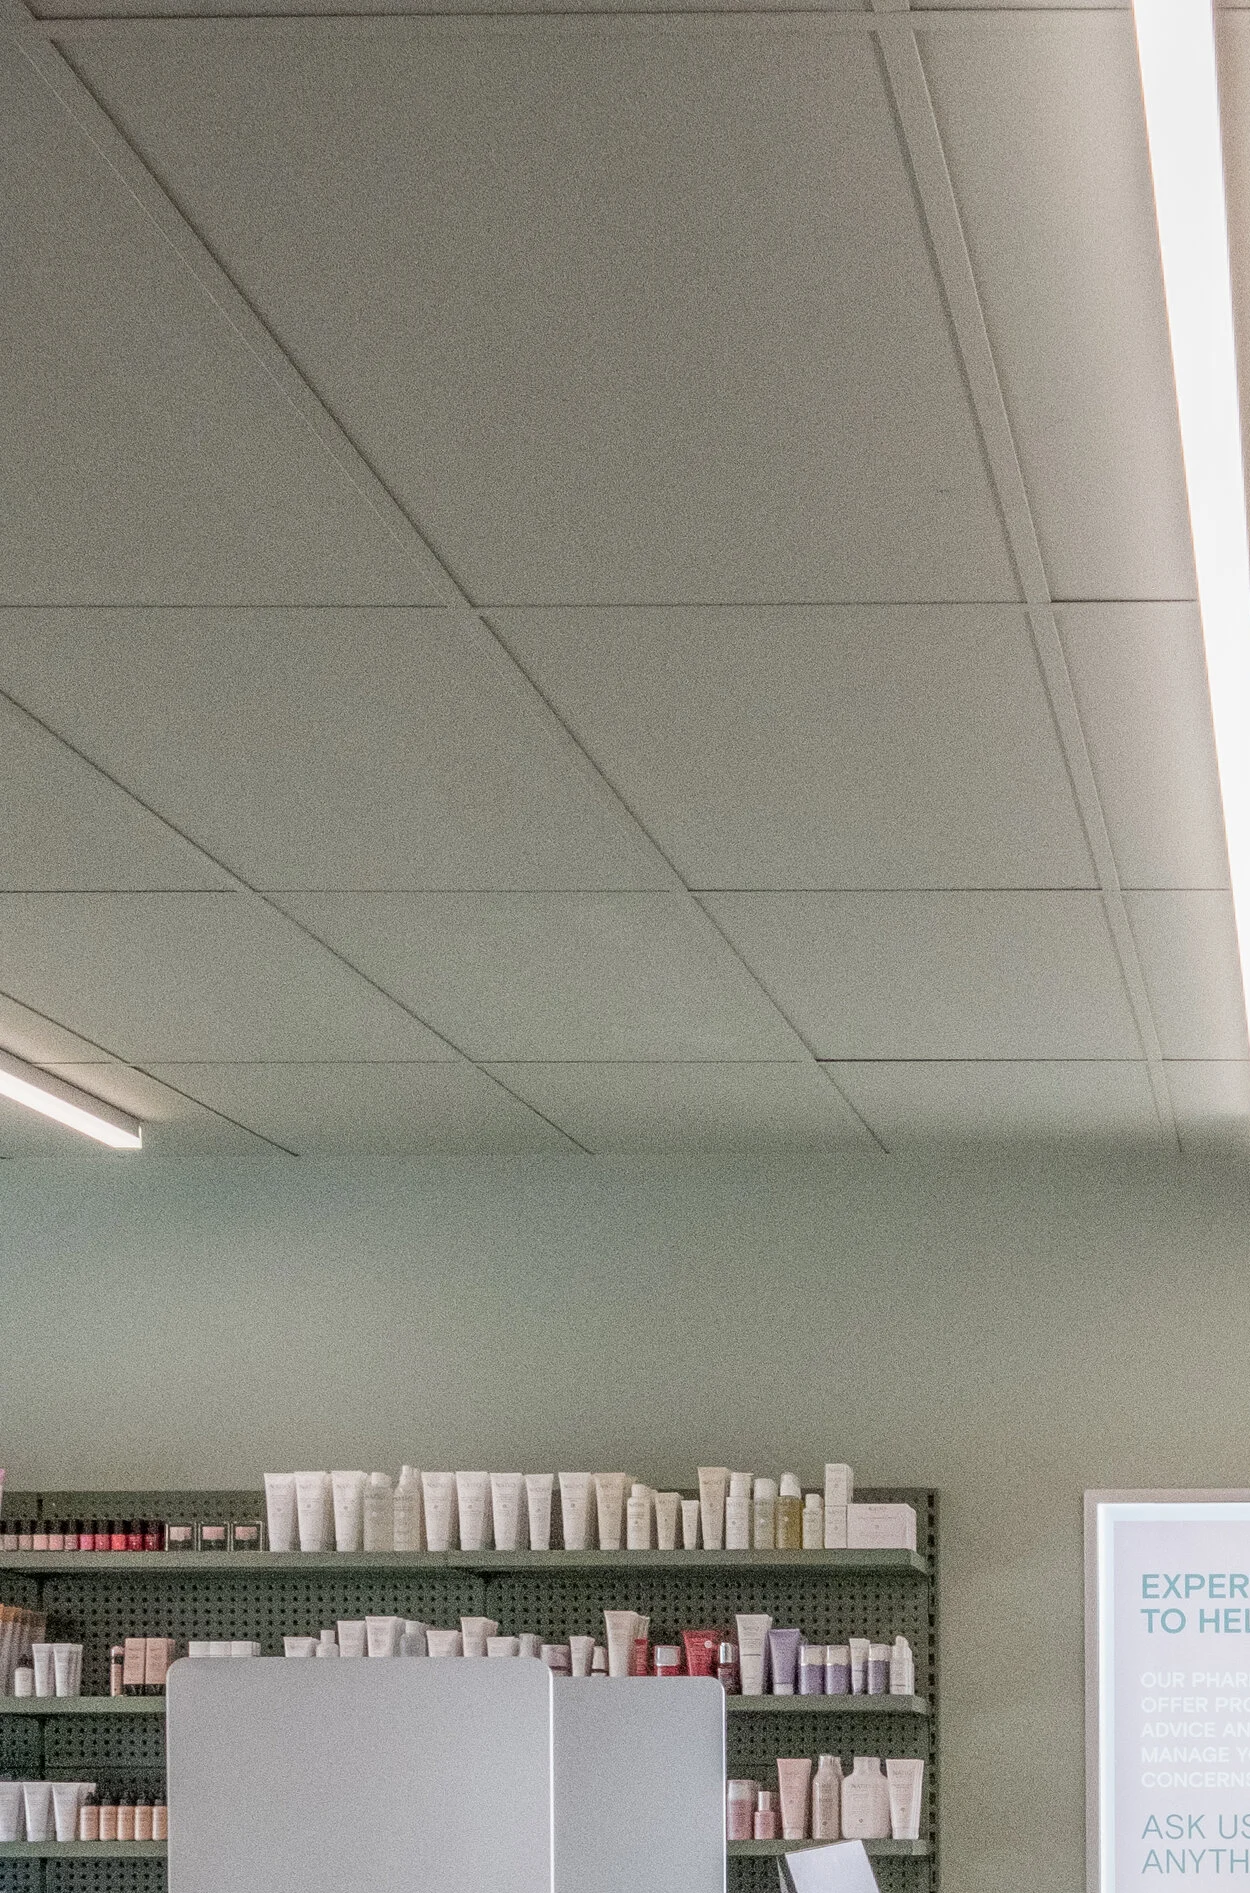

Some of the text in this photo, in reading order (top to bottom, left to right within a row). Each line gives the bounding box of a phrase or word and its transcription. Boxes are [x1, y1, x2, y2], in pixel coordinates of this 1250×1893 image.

[1140, 1608, 1186, 1634] TO
[1141, 1672, 1184, 1688] OUR
[1142, 1697, 1208, 1713] OFFER
[1142, 1722, 1215, 1737] ADVICE
[1142, 1747, 1229, 1762] MANAGE
[1142, 1814, 1205, 1840] ASK
